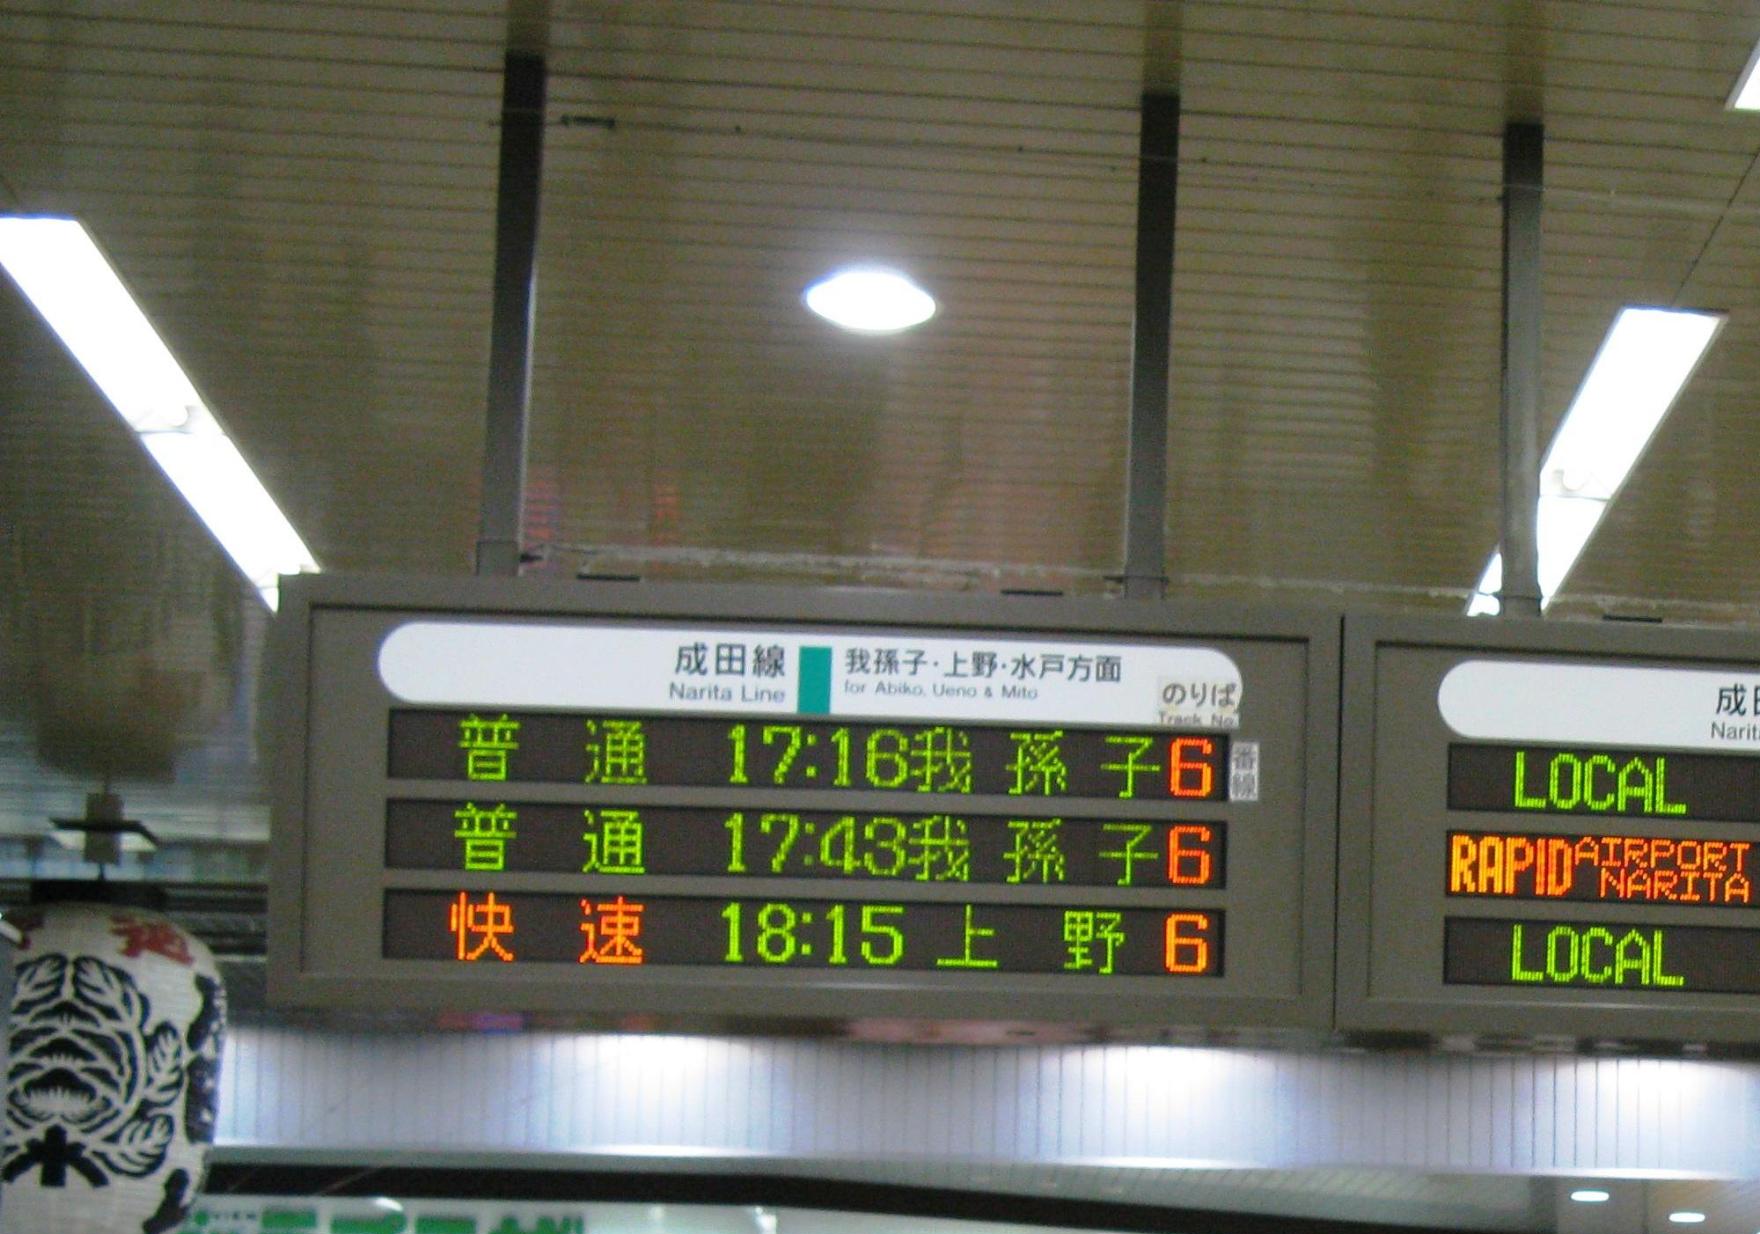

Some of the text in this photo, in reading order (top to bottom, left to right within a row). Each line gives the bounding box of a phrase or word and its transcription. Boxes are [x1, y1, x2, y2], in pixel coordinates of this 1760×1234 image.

[675, 641, 785, 678] 成田線
[845, 647, 1122, 684] 我孫子・上野・水戸方面
[669, 682, 785, 703] Narita Line
[844, 680, 866, 694] for
[932, 683, 977, 699] Ueno
[1001, 684, 1039, 701] Mito
[1162, 681, 1237, 706] のりば
[460, 714, 647, 784] 普通
[729, 725, 910, 788] 17:16
[1168, 737, 1214, 798] 6
[1515, 752, 1686, 814] LOCAL
[455, 803, 645, 874] 普通
[725, 813, 909, 879] 17:43
[1167, 825, 1212, 885] 6
[1450, 834, 1751, 897] RAPID AIRPORT
[1600, 868, 1752, 905] NARITA
[448, 891, 1210, 974] 快速 18:15 上野 6
[1512, 925, 1684, 986] LOCAL
